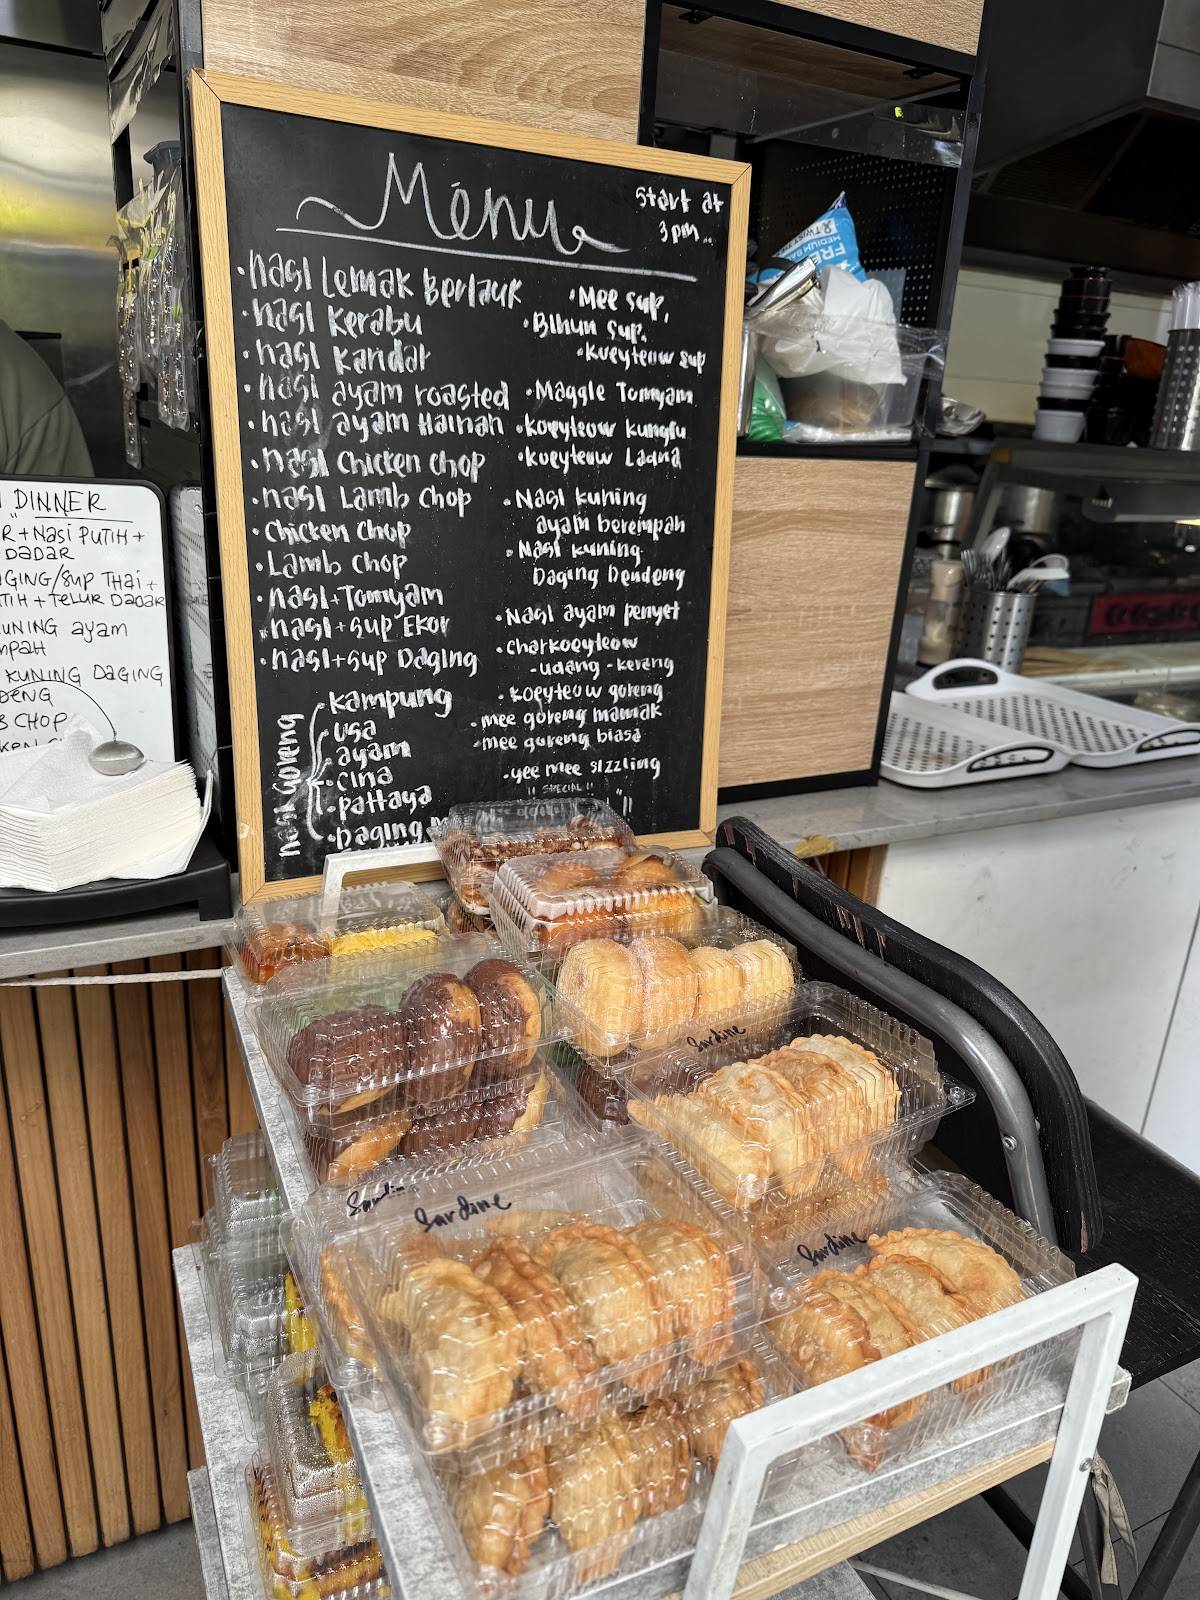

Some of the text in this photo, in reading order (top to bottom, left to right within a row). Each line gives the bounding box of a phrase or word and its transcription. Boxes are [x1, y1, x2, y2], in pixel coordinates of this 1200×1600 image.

[702, 192, 725, 214] at
[810, 242, 846, 266] FRE
[578, 285, 619, 311] Mee
[331, 380, 403, 411] ayam
[415, 379, 511, 411] roasted
[331, 411, 410, 444] ayam
[14, 488, 107, 517] DINNER
[340, 481, 411, 511] Lamb
[535, 514, 590, 541] ayam
[267, 549, 342, 579] Lamb
[0, 592, 28, 608] TIH
[562, 603, 616, 629] ayam
[623, 600, 681, 627] penyet
[71, 620, 128, 643] ayam
[481, 711, 517, 730] mee
[335, 740, 412, 770] ayam
[481, 734, 519, 752] mee
[510, 764, 541, 785] yee
[545, 761, 583, 777] mee
